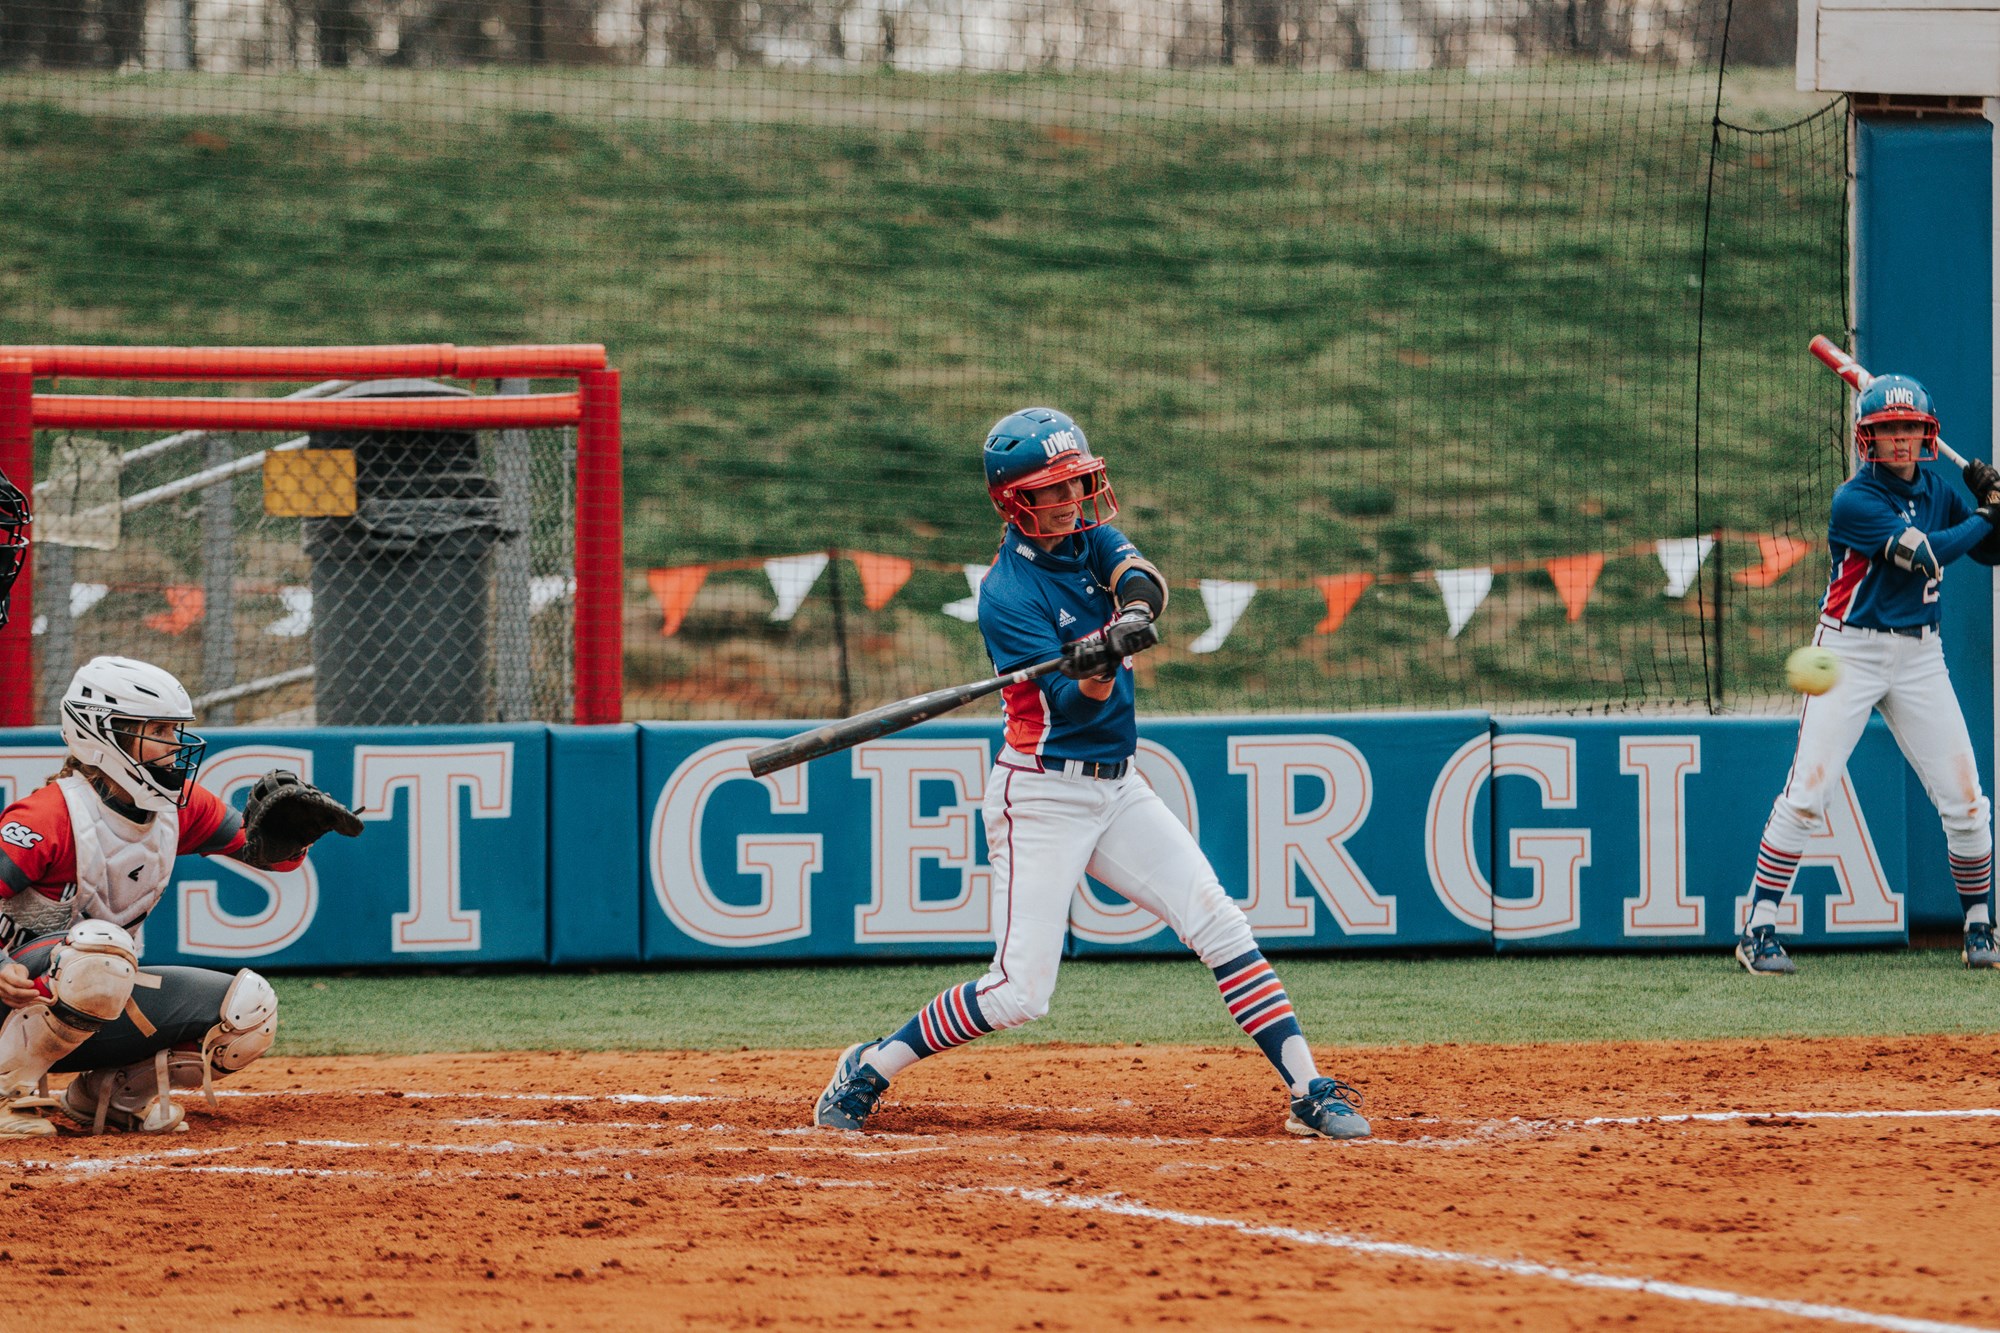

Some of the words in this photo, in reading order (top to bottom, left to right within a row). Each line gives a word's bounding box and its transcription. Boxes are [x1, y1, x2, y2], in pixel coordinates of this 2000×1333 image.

[1885, 387, 1914, 406] UWG
[1041, 430, 1078, 458] UWG
[1, 821, 43, 849] GSC
[0, 744, 513, 957] ST
